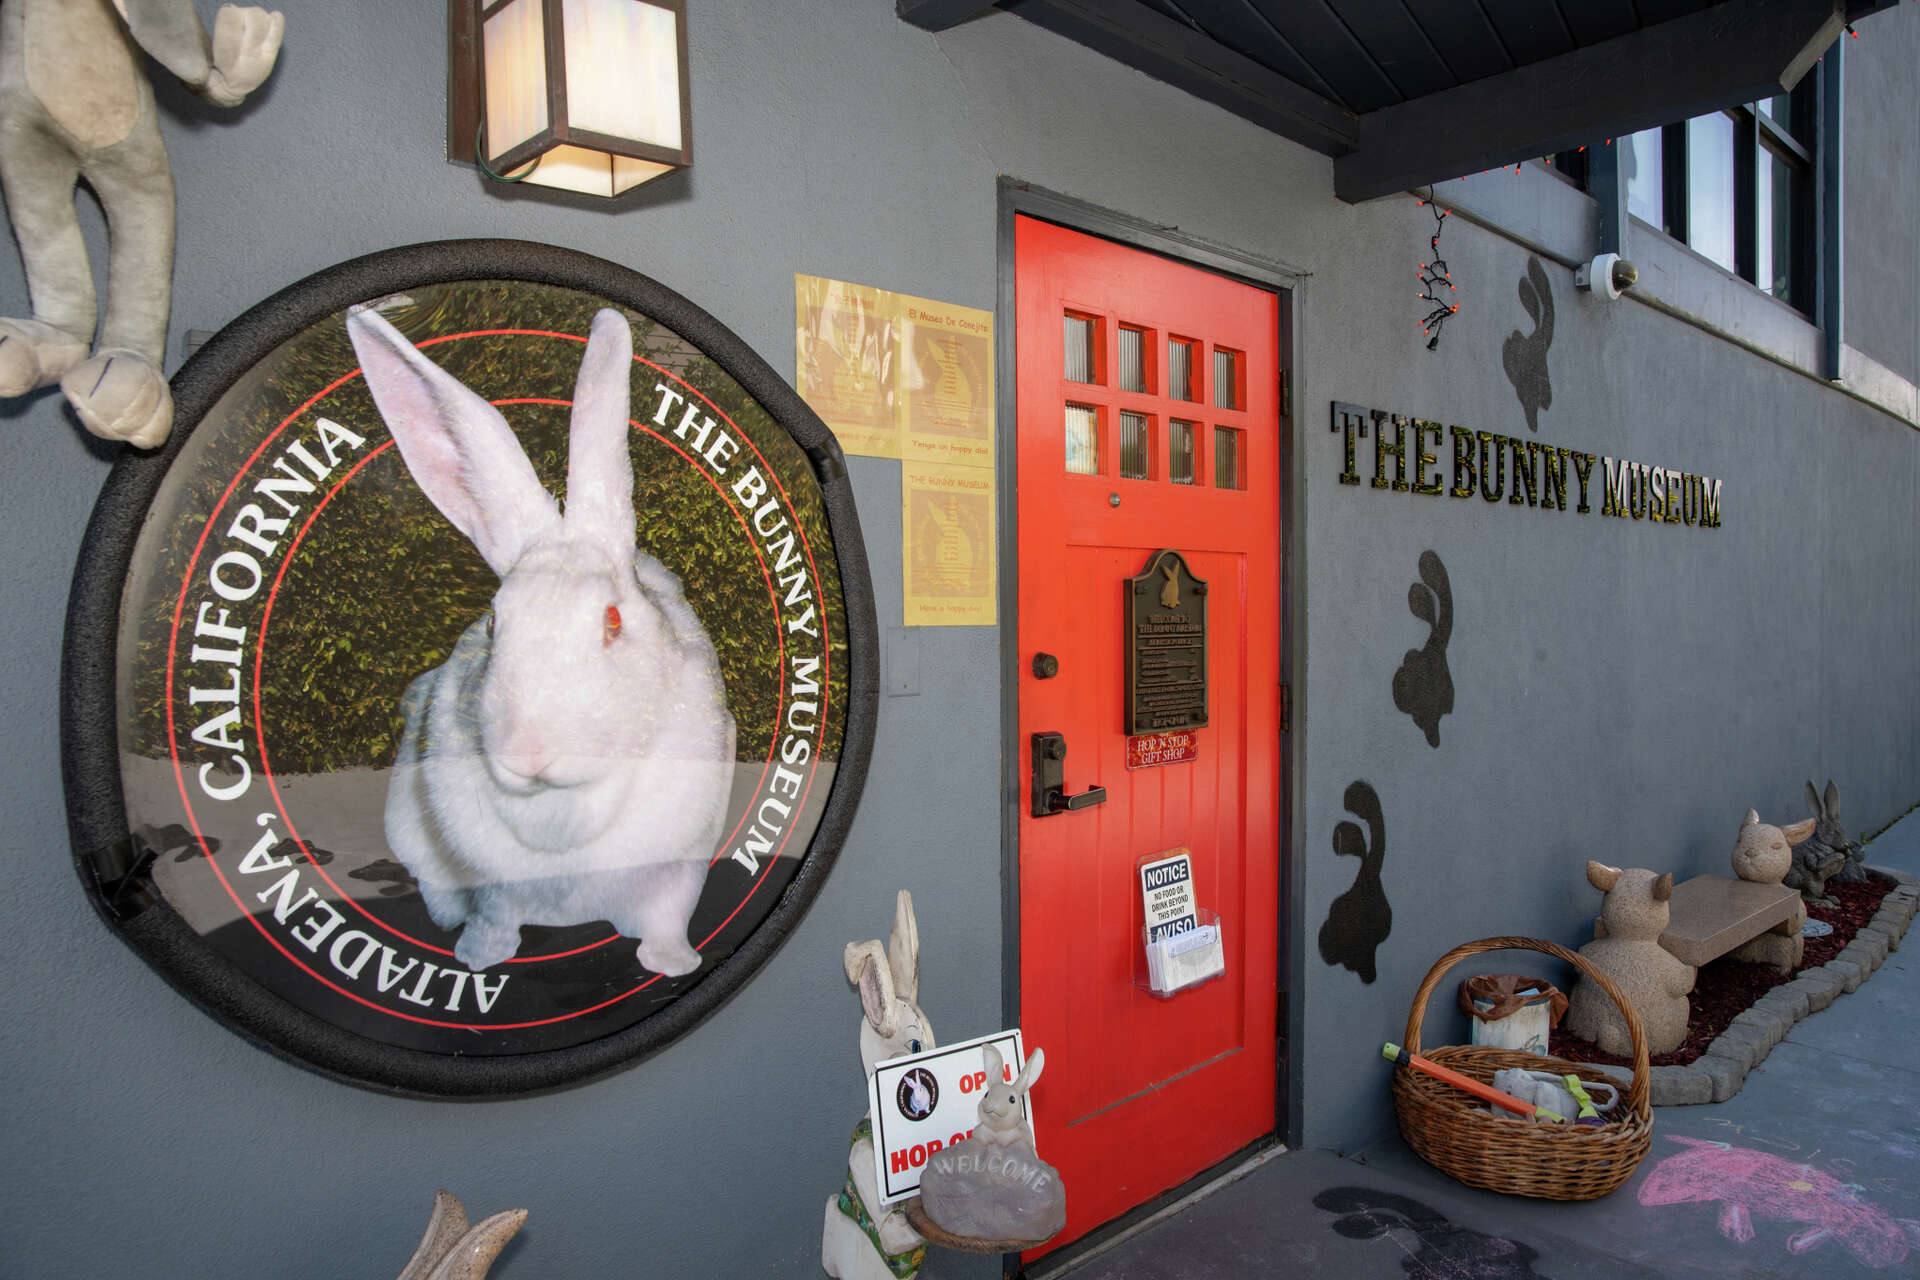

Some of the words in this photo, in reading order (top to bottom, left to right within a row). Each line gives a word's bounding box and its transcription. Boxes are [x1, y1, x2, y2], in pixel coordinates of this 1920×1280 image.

[654, 384, 739, 475] THE
[1330, 400, 1443, 496] THE
[1450, 424, 1597, 513] BUNNY
[1601, 455, 1723, 528] MUSEUM
[910, 474, 926, 485] THE
[957, 479, 989, 490] MUSEUM
[731, 465, 818, 639] BUNNY
[189, 417, 366, 800] CALIFORNIA
[1137, 738, 1157, 752] HOP
[1167, 734, 1189, 748] STOP
[1141, 750, 1162, 764] GIFT
[1163, 747, 1185, 761] SHOP
[732, 655, 820, 877] MUSEUM
[1147, 862, 1187, 888] NOTICE
[1151, 900, 1168, 913] DRINK
[1168, 895, 1189, 908] BEYOND
[1154, 891, 1162, 900] NO
[1162, 887, 1176, 898] FOOD
[1176, 885, 1184, 893] OR
[238, 812, 509, 1013] ALTADENA,
[1158, 910, 1170, 921] THIS
[1170, 905, 1185, 917] POINT
[960, 1064, 1011, 1094] OPN
[891, 1140, 943, 1174] HOP
[933, 1153, 1051, 1193] WELCOME
